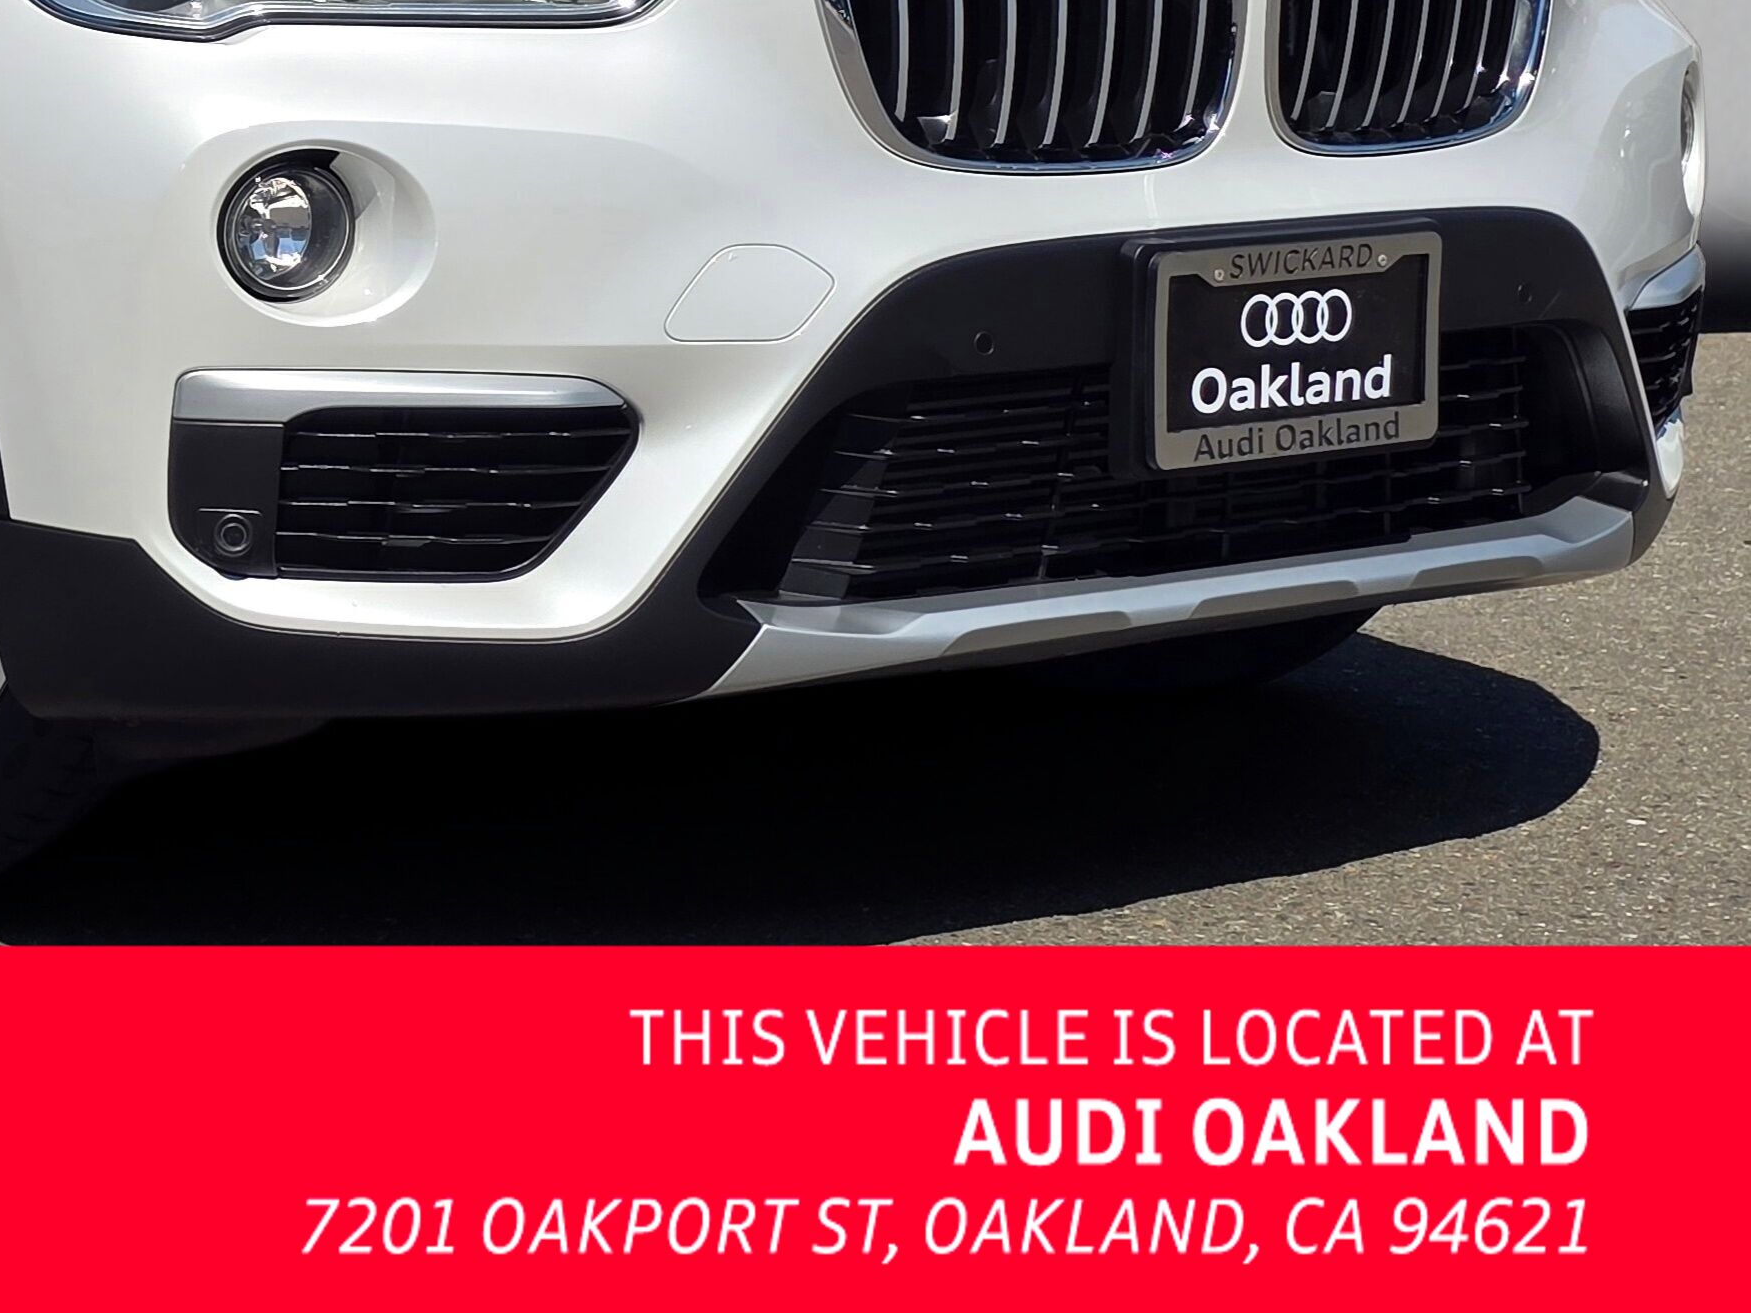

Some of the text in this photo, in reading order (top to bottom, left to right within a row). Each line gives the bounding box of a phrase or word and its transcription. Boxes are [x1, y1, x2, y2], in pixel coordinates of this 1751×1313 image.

[1229, 243, 1374, 280] SWICKARD
[1190, 353, 1393, 415] Oakland
[1193, 411, 1400, 463] Audi Oakland
